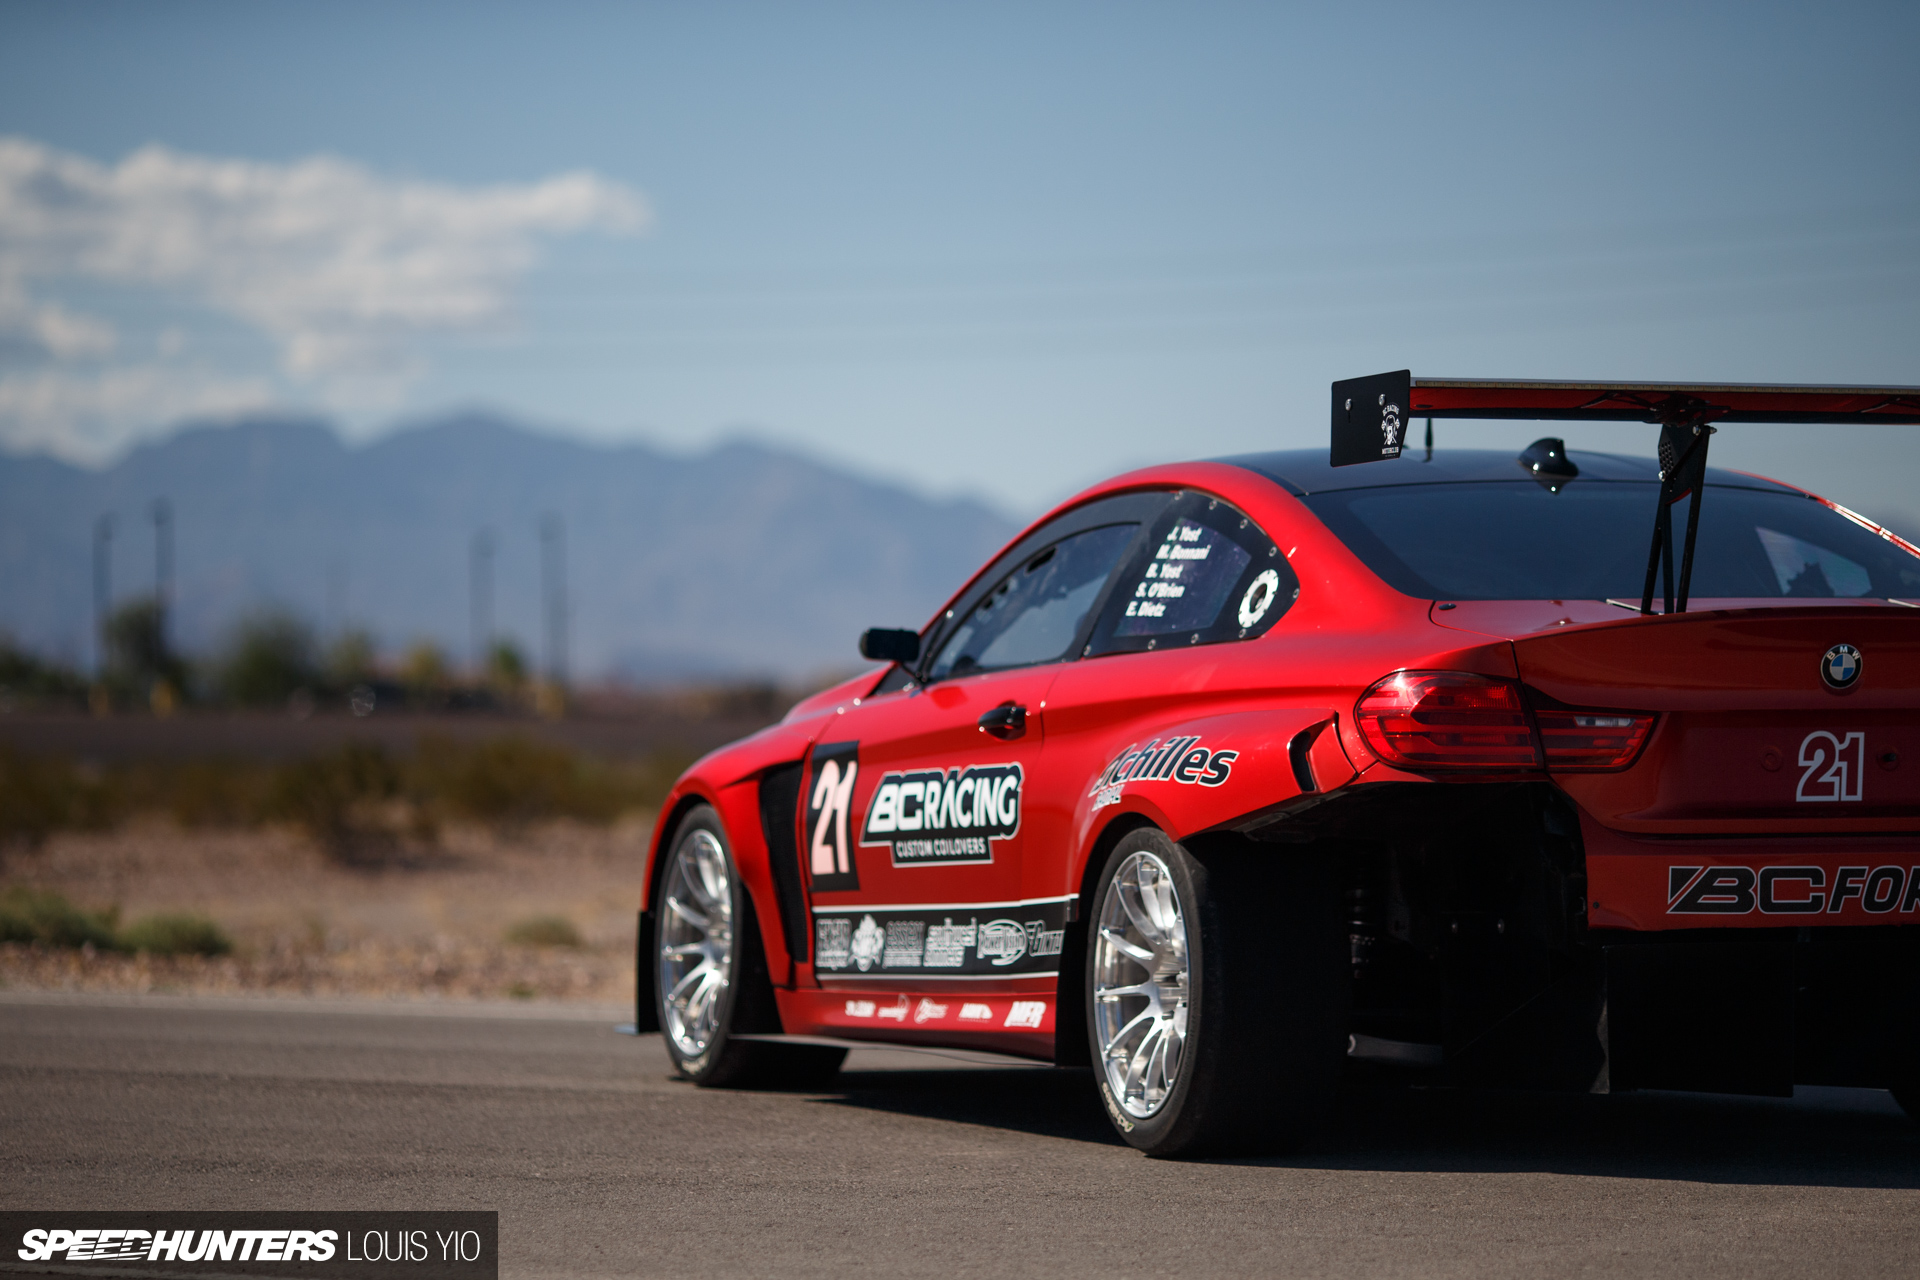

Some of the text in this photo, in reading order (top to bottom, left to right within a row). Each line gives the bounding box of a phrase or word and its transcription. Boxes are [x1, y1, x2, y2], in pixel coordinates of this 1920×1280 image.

[1179, 526, 1203, 542] Yost
[1155, 544, 1170, 559] M.
[1159, 563, 1184, 579] Yost
[1135, 582, 1186, 598] S. O'Brien
[1125, 601, 1138, 617] E.
[1826, 645, 1860, 661] BMW
[1088, 735, 1240, 797] Achilles
[1796, 730, 1866, 802] 21
[811, 759, 858, 876] 21
[896, 837, 987, 859] CUSTOM COILOVERS
